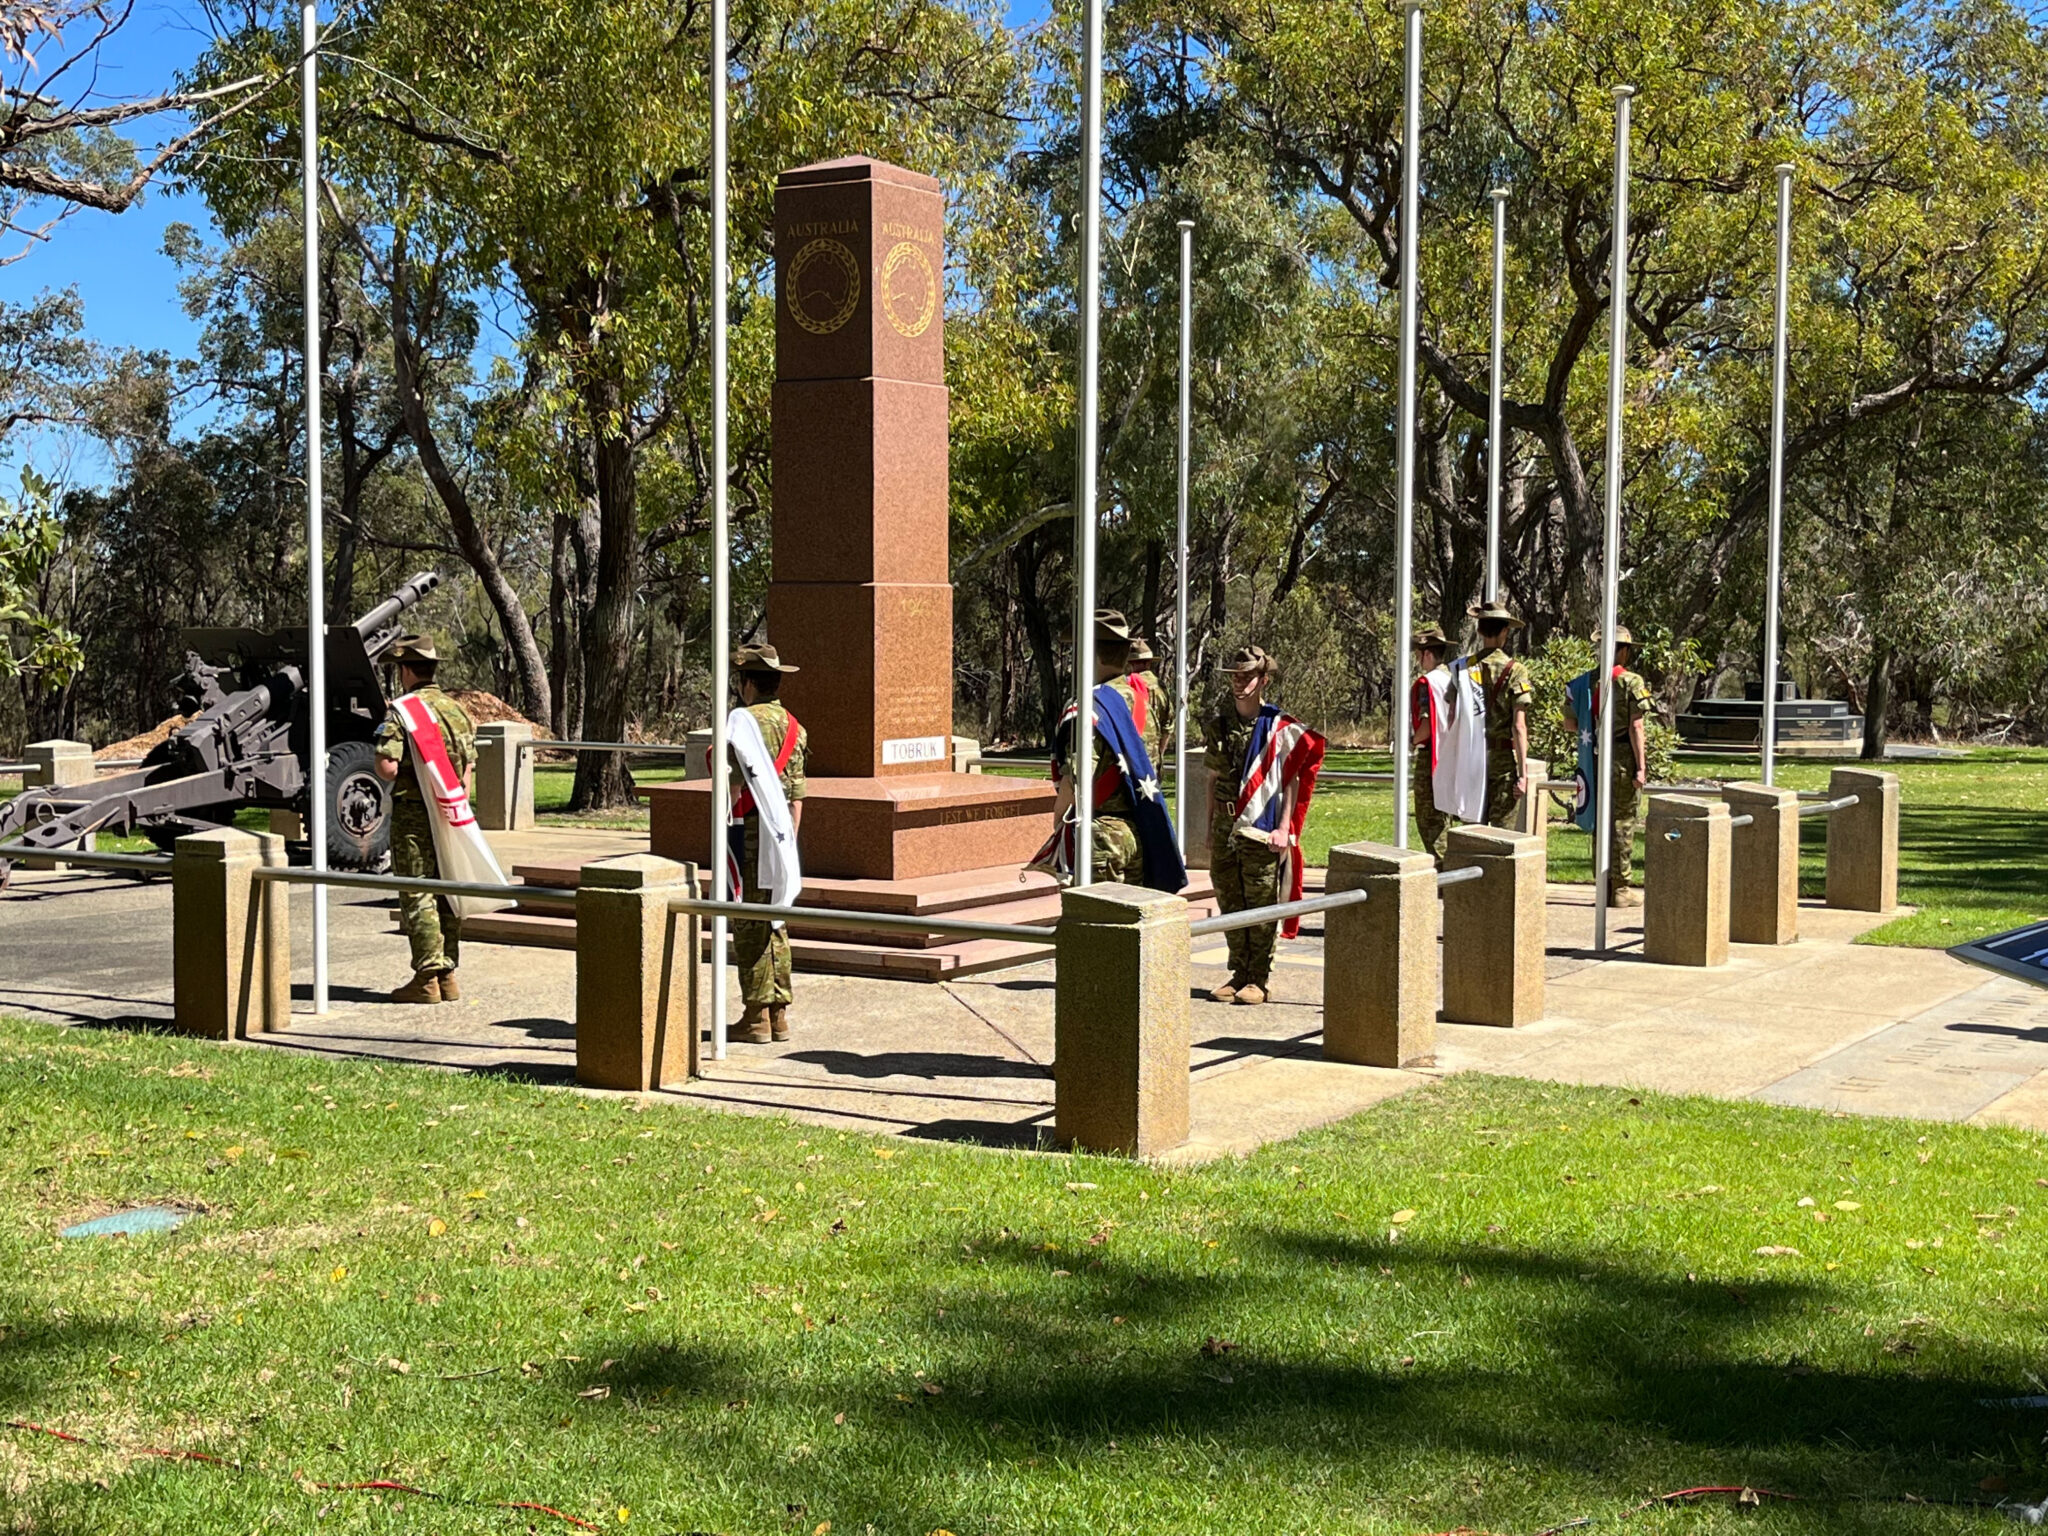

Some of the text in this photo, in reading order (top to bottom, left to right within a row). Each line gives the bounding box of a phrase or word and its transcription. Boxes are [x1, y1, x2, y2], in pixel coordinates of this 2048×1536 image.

[788, 219, 859, 238] AUSTRALIA
[881, 222, 935, 244] AUSTRALIA
[890, 742, 937, 760] TOBRUK
[939, 803, 1022, 826] LEST WE FORGET
[1883, 1036, 1962, 1066] SILENT
